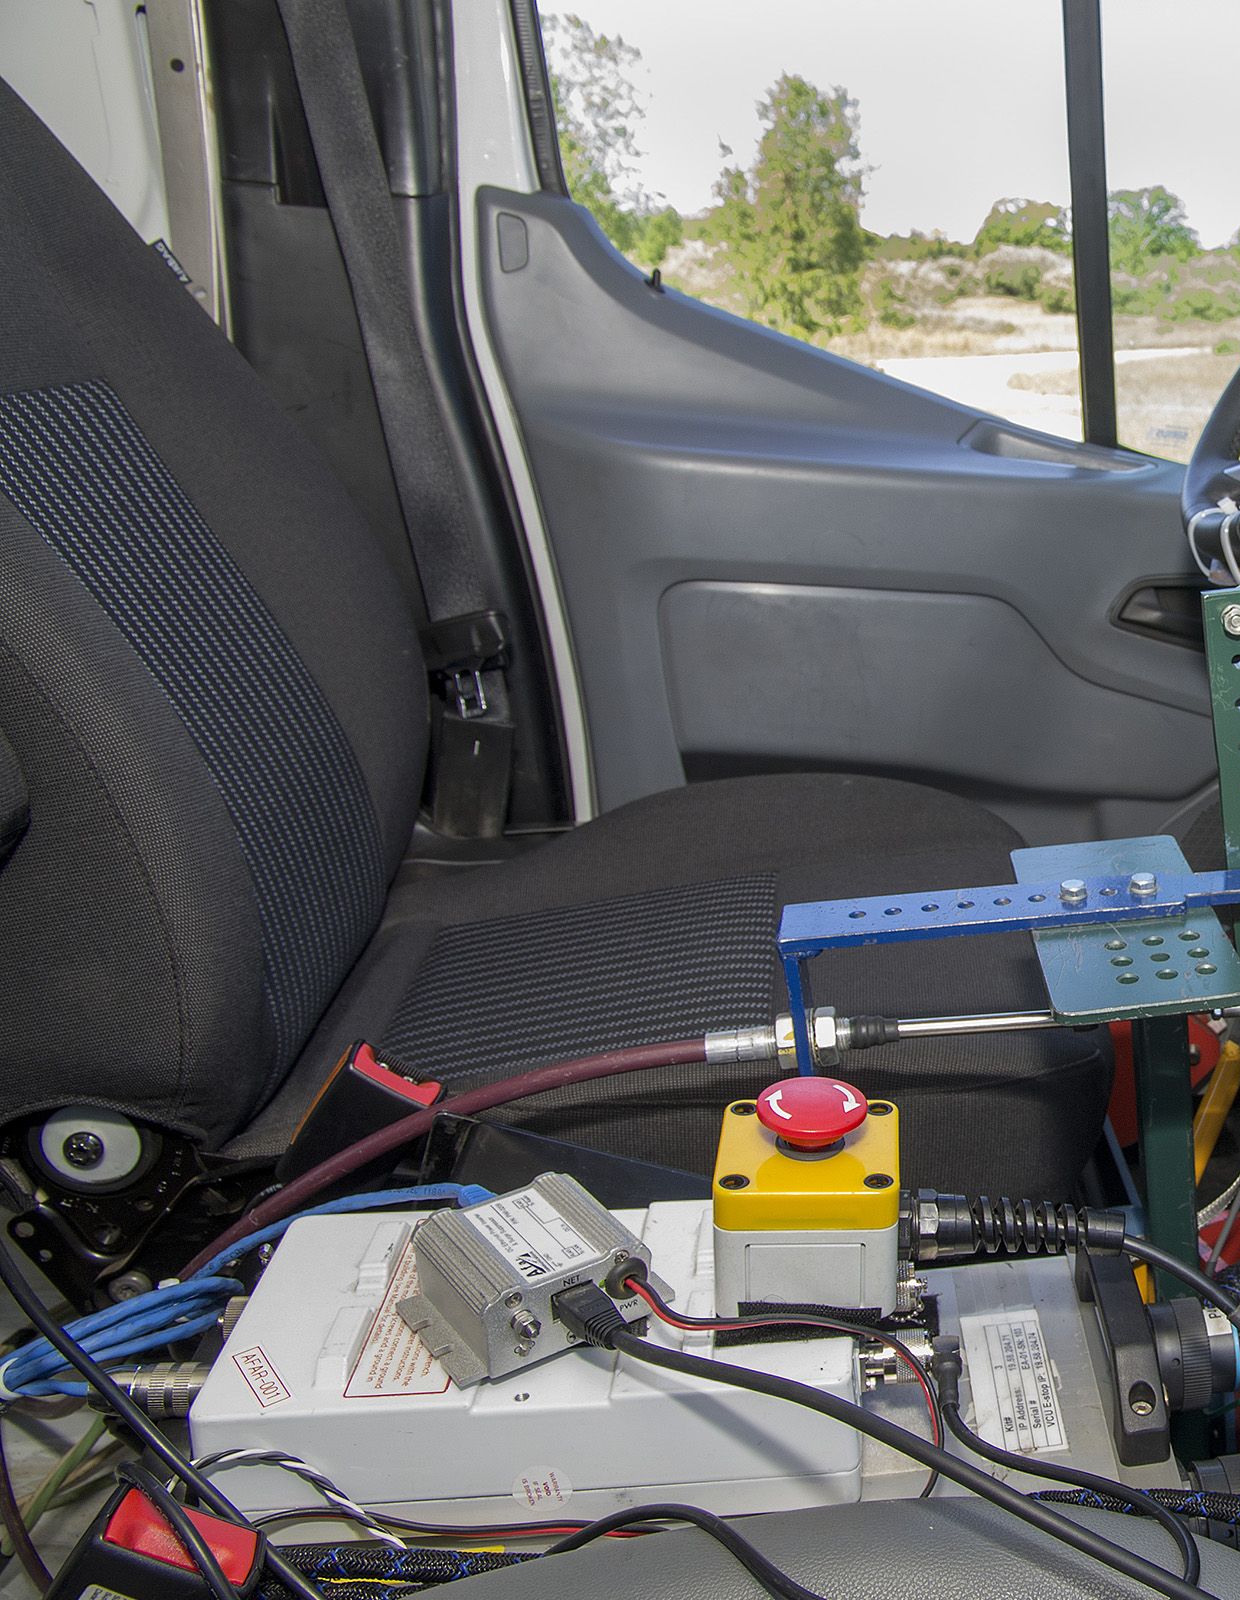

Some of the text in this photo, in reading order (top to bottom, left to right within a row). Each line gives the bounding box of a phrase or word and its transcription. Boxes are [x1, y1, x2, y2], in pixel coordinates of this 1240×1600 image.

[563, 1274, 580, 1287] NET
[619, 1299, 638, 1312] PWR
[241, 1354, 281, 1400] AFAR-001
[1041, 1383, 1052, 1409] E-stop
[1014, 1387, 1028, 1431] IP Address:
[1029, 1403, 1042, 1429] Serial
[1003, 1416, 1014, 1433] Kit#
[1044, 1411, 1055, 1428] VCU
[524, 1484, 536, 1506] BROKEN
[533, 1487, 543, 1501] SEAL
[542, 1481, 551, 1497] VOID
[548, 1472, 563, 1502] WARRANTY
